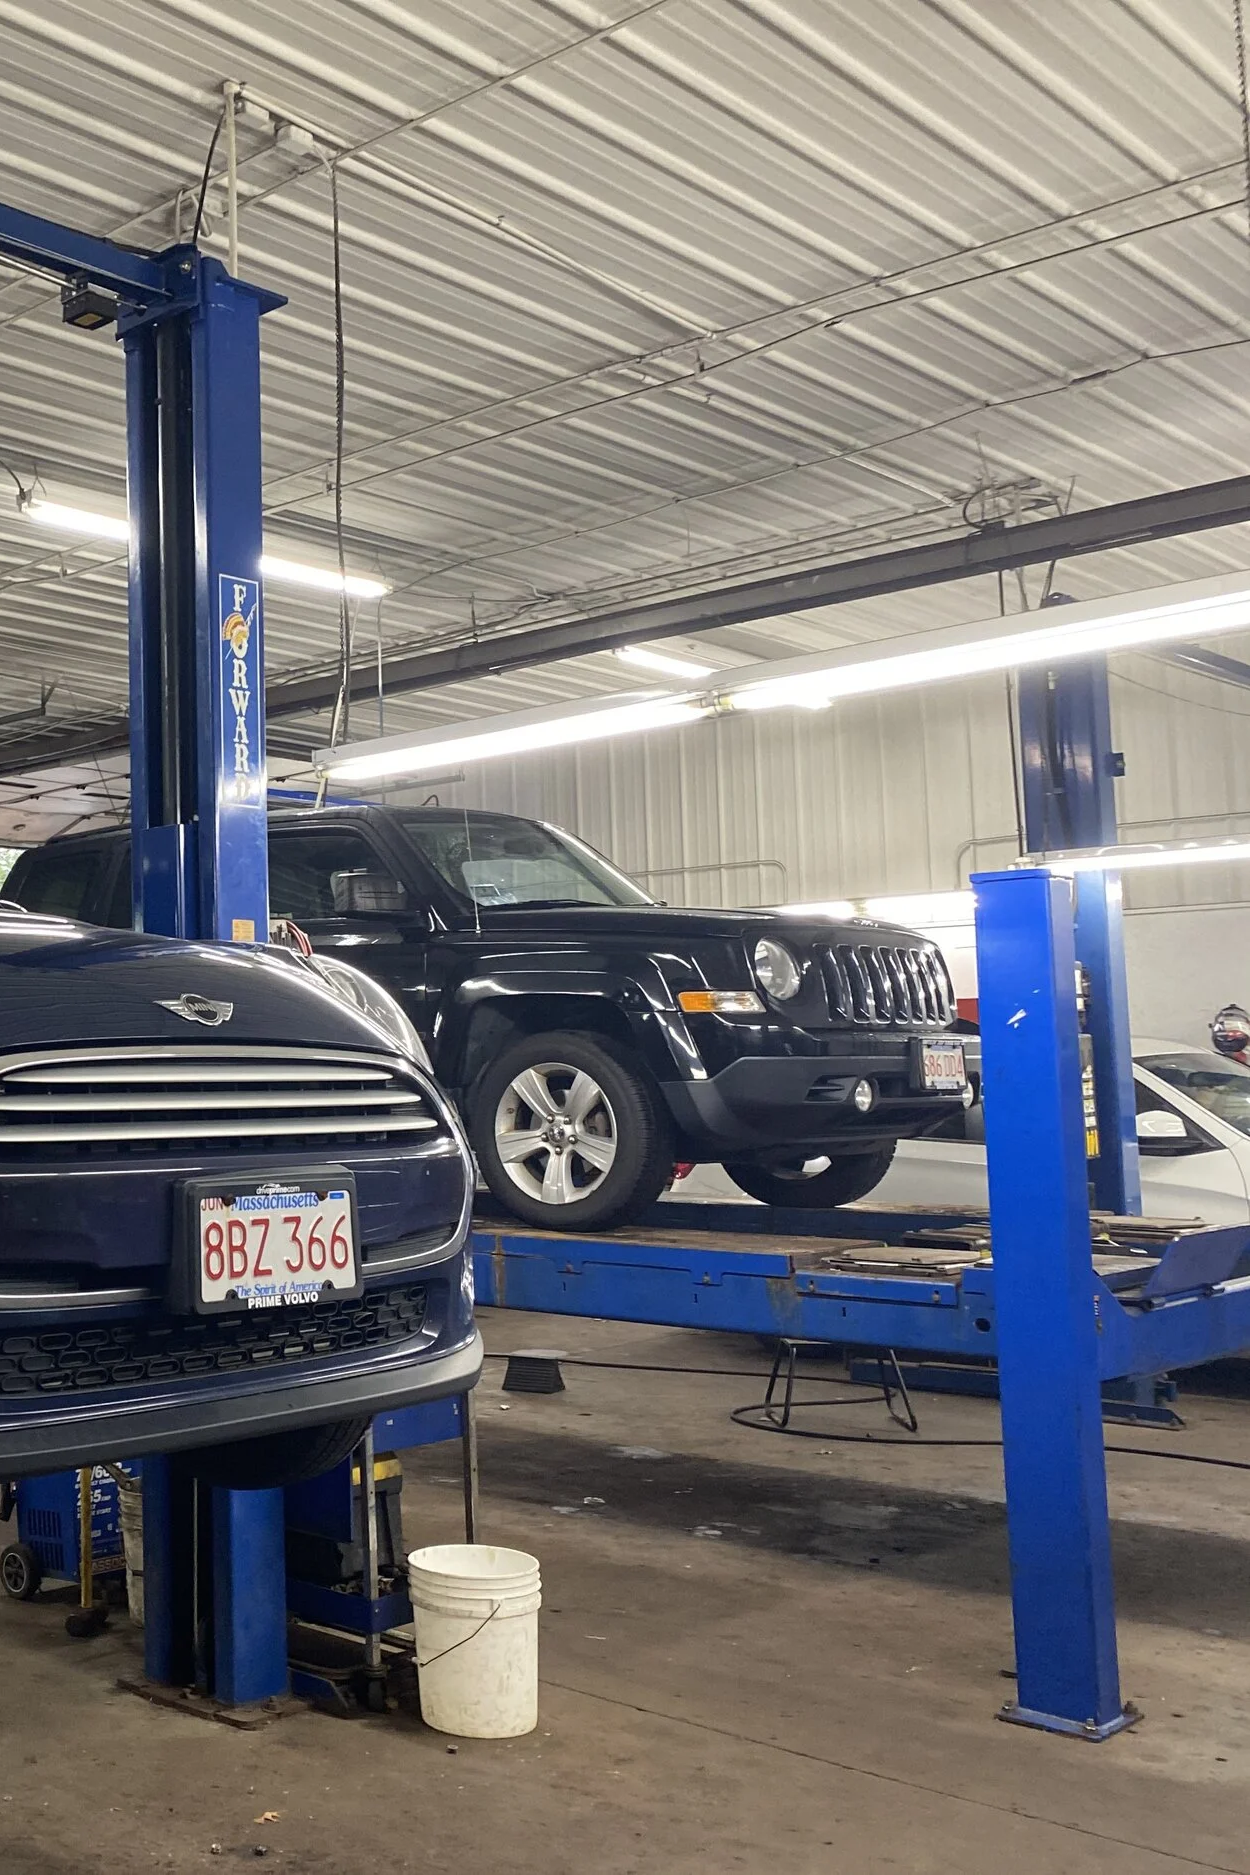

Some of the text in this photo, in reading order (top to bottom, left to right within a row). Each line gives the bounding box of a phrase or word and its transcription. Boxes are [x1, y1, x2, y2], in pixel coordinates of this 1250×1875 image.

[229, 584, 250, 800] FORWARD
[201, 1198, 223, 1211] JUN
[205, 1214, 349, 1281] 8BZ 366
[235, 1285, 252, 1297] The
[254, 1283, 277, 1296] Spirit
[279, 1281, 288, 1294] of
[247, 1291, 319, 1309] PRIME VOLVO
